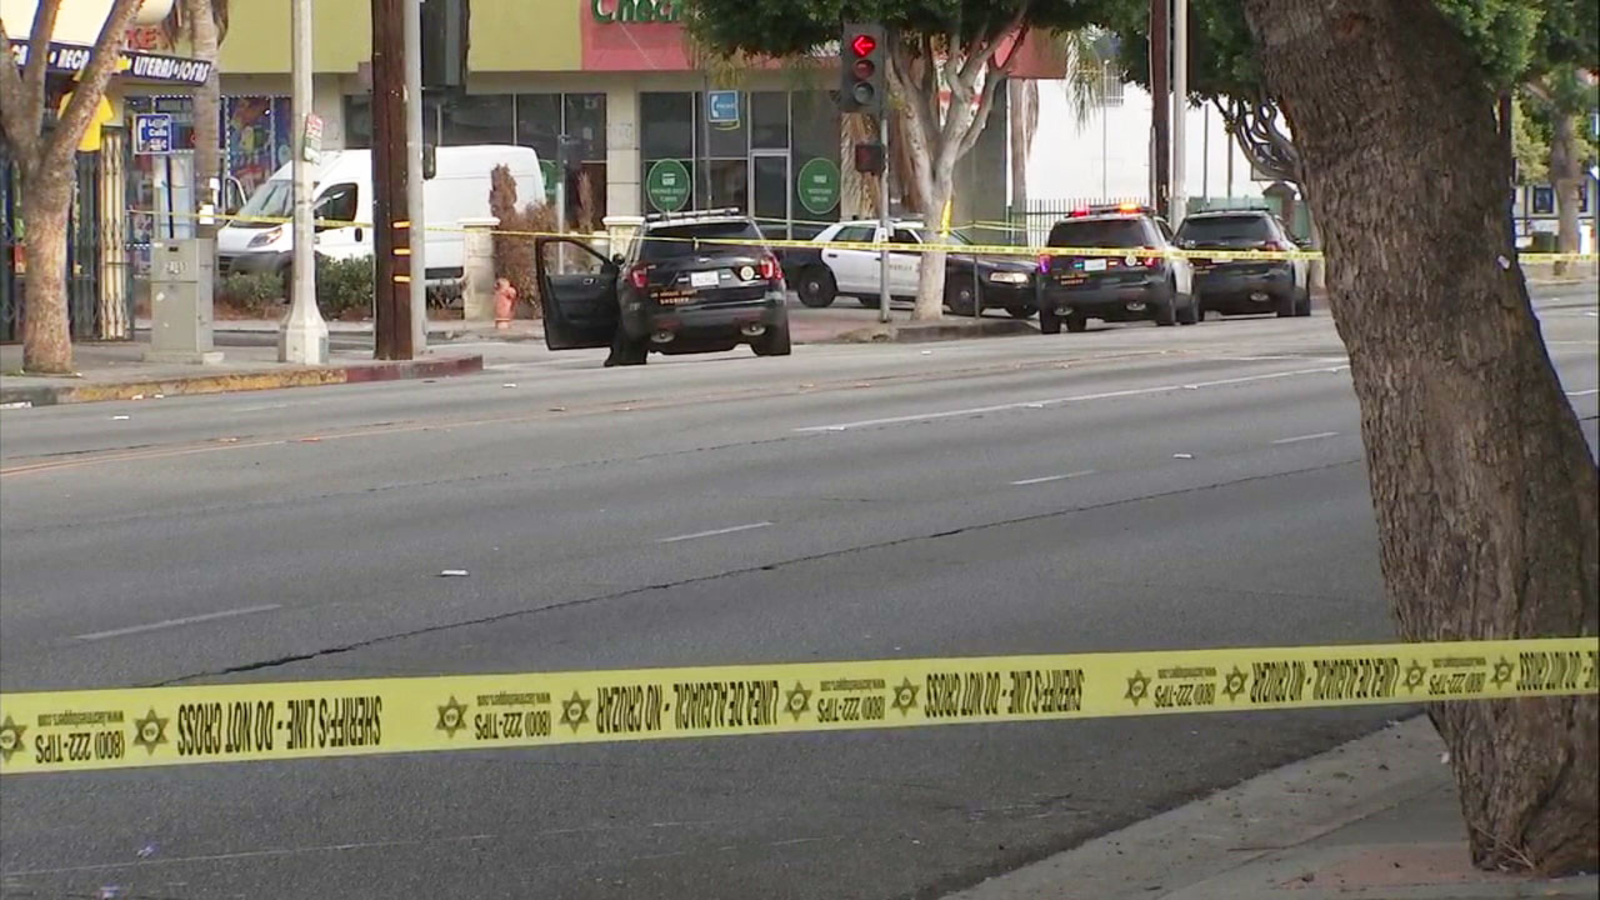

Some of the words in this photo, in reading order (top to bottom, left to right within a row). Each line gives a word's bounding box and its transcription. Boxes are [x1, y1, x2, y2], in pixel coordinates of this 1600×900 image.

[596, 685, 644, 734] CRUZAR
[645, 684, 662, 730] NO
[674, 682, 727, 730] ALGUACIL
[729, 682, 744, 726] DE
[746, 680, 778, 726] LINEA
[817, 698, 860, 723] 222-TIPS
[925, 673, 960, 718] CROSS
[961, 672, 983, 716] NOT
[984, 672, 999, 716] DO
[1008, 671, 1031, 714] LINE
[94, 730, 125, 760] (800)
[178, 703, 222, 756] CROSS
[225, 701, 252, 753] NOT
[254, 700, 274, 752] DO
[286, 699, 315, 750] LINE
[319, 696, 382, 749] SHERIFF'S
[474, 712, 522, 740] 222-TIPS
[524, 710, 551, 738] (800)
[35, 733, 92, 764] 222-TIPS
